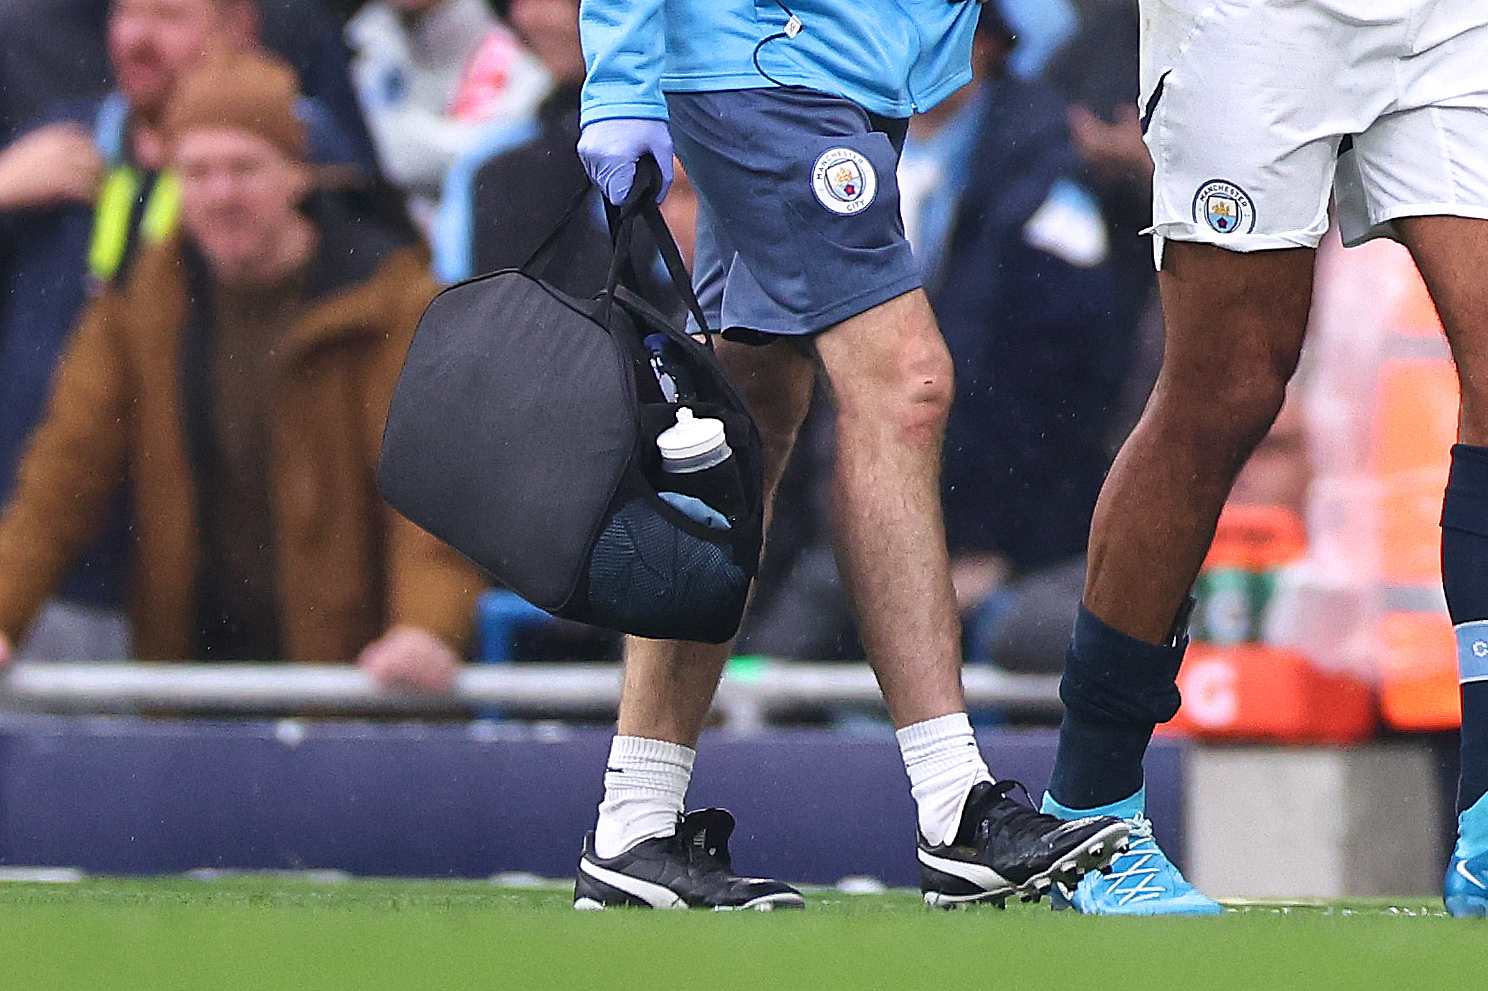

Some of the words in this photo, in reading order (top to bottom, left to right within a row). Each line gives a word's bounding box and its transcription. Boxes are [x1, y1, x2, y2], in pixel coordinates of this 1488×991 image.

[816, 150, 864, 180] MANCHESTER
[846, 199, 865, 212] CITY
[1199, 184, 1248, 208] MANCHESTER
